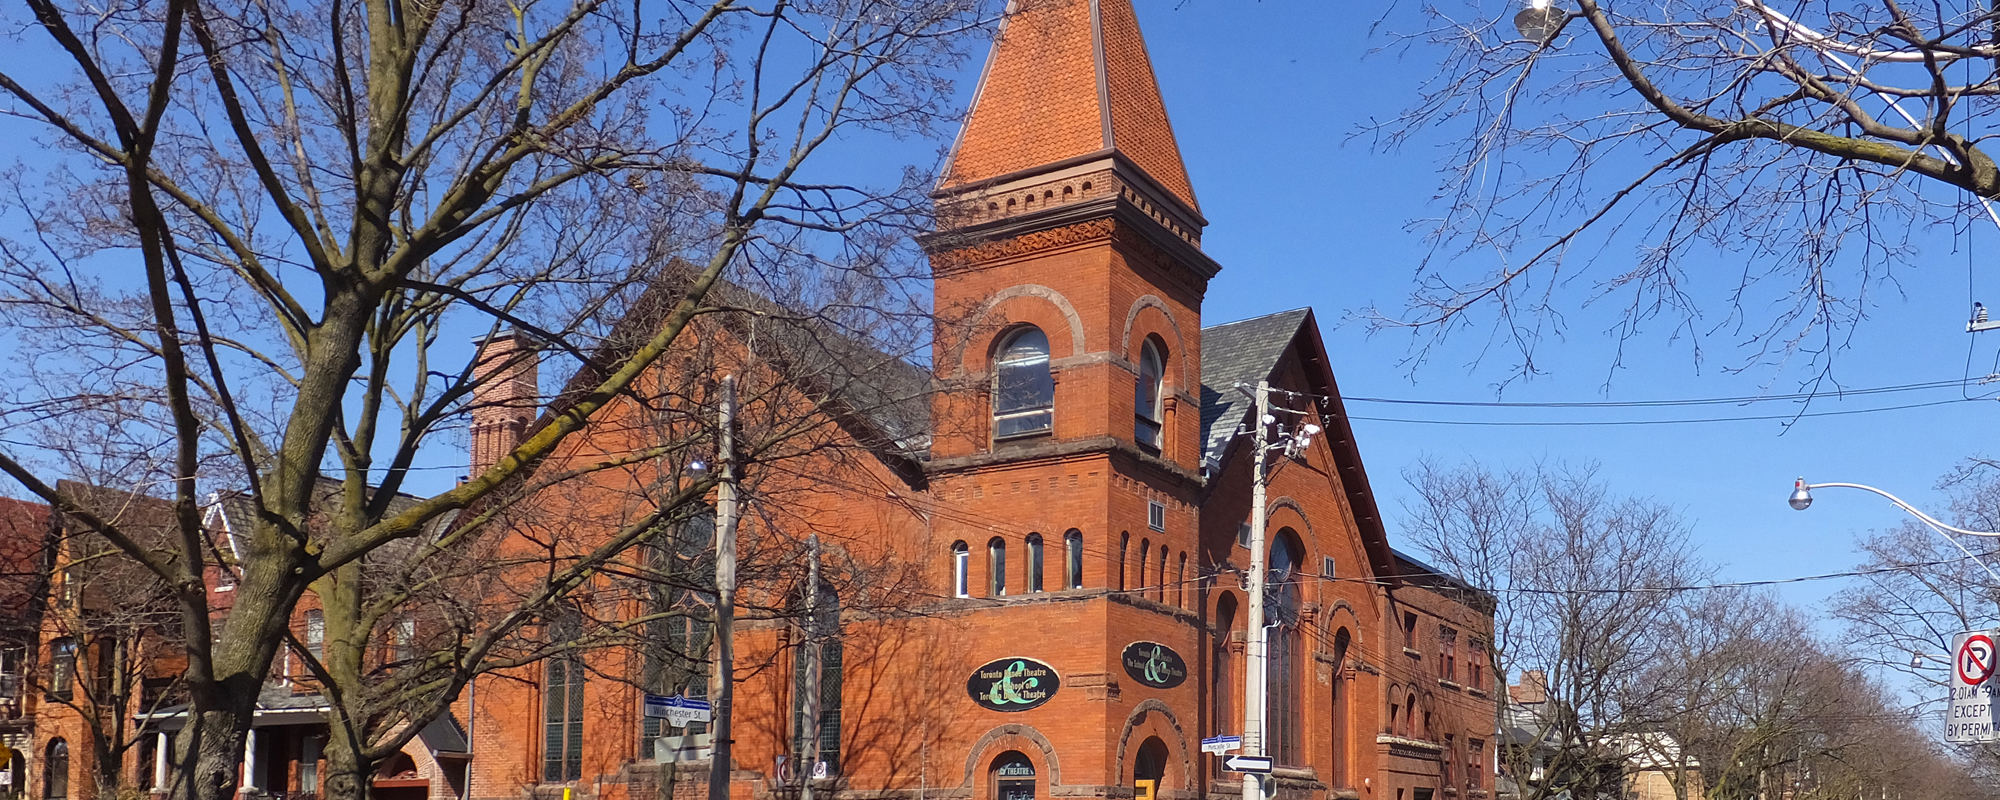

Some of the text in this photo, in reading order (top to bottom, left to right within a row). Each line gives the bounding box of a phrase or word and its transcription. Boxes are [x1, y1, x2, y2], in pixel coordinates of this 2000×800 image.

[980, 670, 1003, 679] Toronto
[1023, 668, 1046, 677] Theatre
[980, 691, 1002, 700] Toronto
[1023, 689, 1046, 699] Theatre
[653, 706, 691, 719] Winchester
[1954, 704, 1992, 718] EXCEPT
[1948, 721, 1997, 737] BY PERMIT
[1007, 767, 1029, 775] THEATRE
